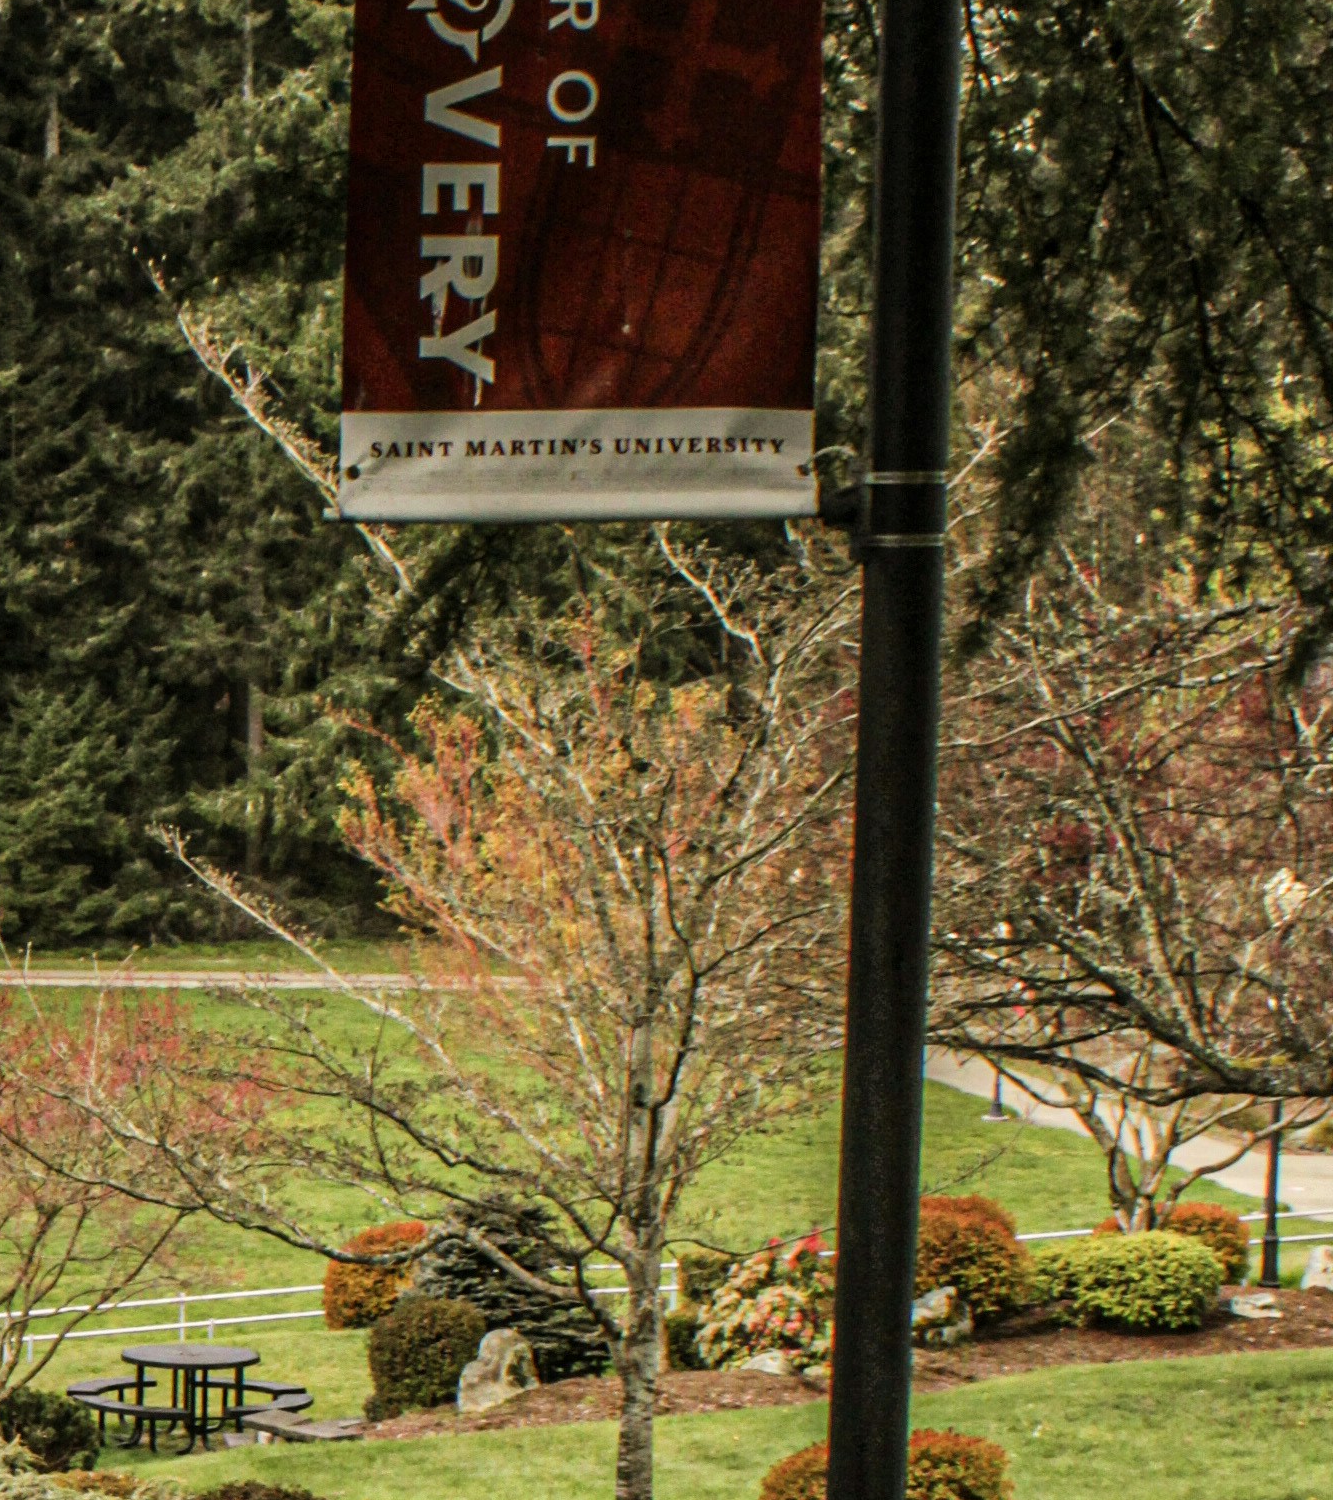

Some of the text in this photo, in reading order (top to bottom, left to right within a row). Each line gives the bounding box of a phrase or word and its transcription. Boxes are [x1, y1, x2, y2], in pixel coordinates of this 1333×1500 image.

[546, 68, 600, 168] OF
[370, 436, 786, 459] SAINT MARTIN'S UNIVERSITY
